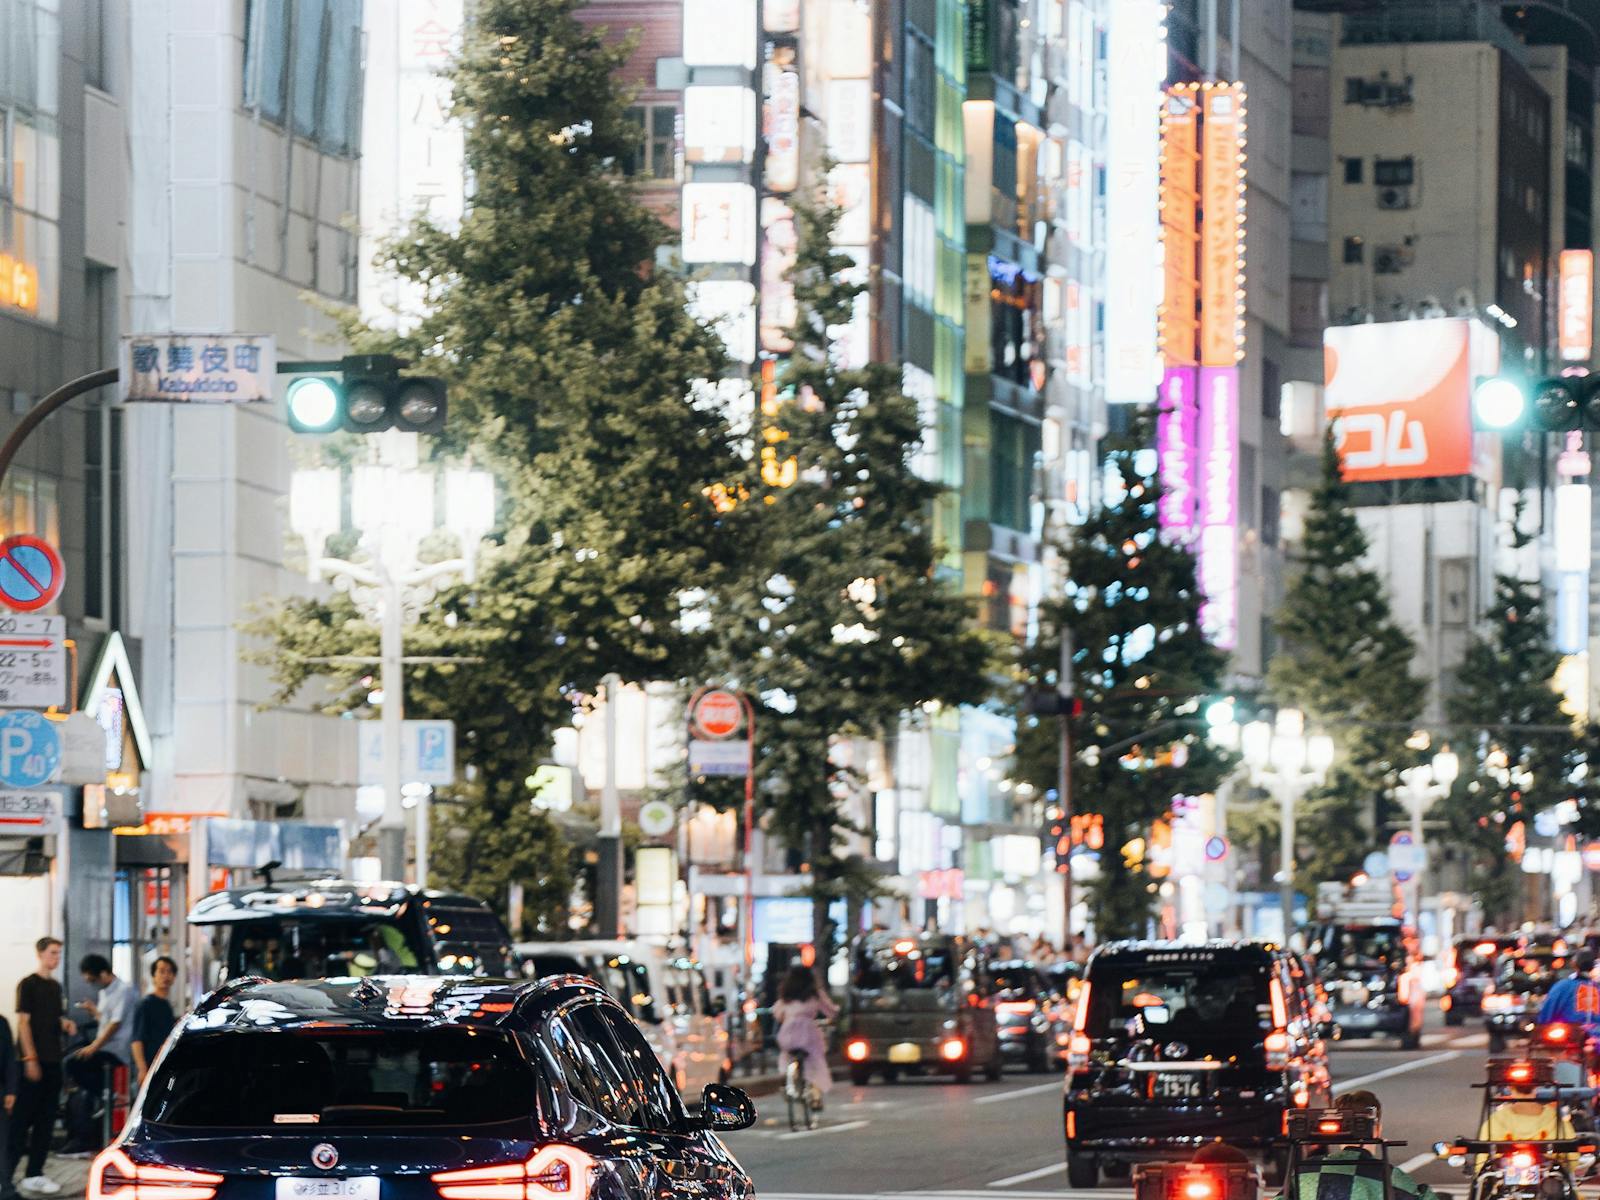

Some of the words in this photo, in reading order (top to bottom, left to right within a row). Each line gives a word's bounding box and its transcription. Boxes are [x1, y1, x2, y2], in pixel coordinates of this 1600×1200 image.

[132, 345, 261, 373] 歌舞伎町
[159, 377, 238, 393] Kabukicho
[2, 728, 33, 777] P
